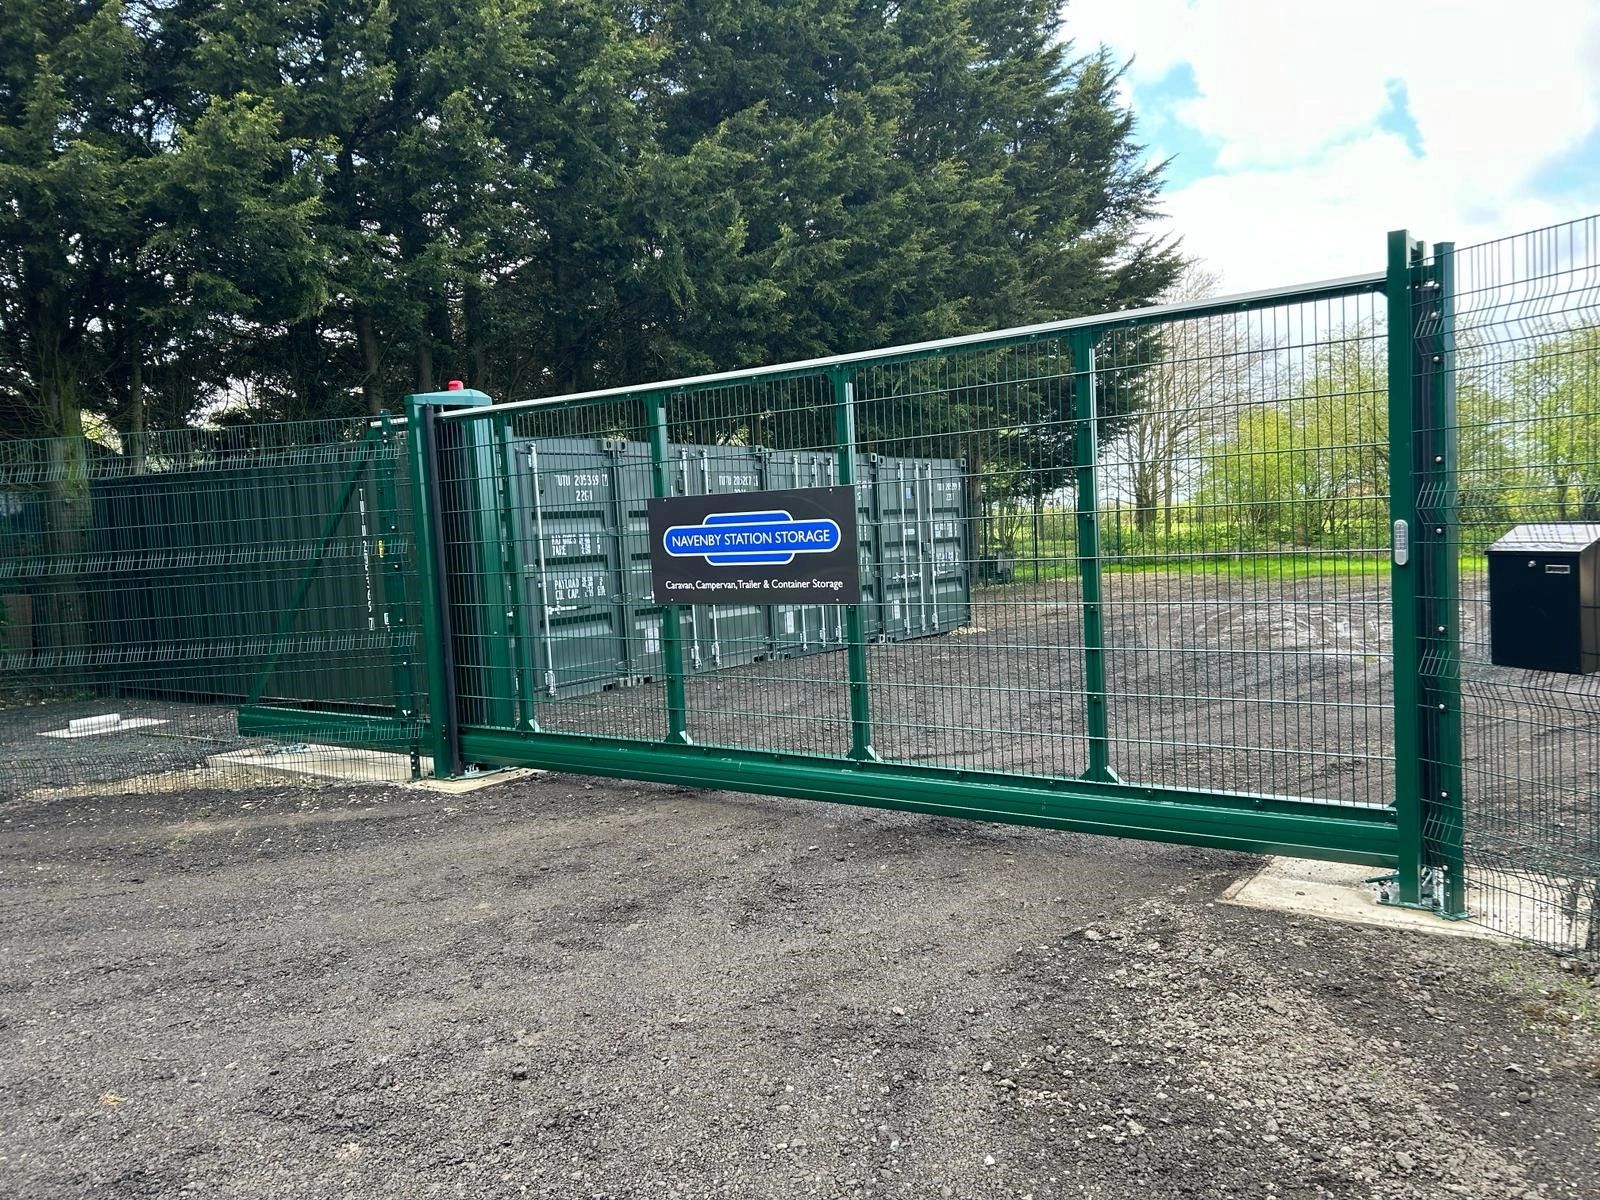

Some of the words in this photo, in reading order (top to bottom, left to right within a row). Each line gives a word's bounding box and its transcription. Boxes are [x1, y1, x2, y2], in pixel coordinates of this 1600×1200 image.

[671, 533, 722, 547] NAVENBY
[724, 531, 772, 546] STATION
[775, 529, 831, 544] STORAGE
[665, 580, 695, 590] Caravan,
[695, 579, 738, 592] Campervan,
[737, 579, 762, 589] Trailer
[763, 579, 770, 589] &
[771, 579, 811, 589] Container
[812, 578, 844, 591] Storage
